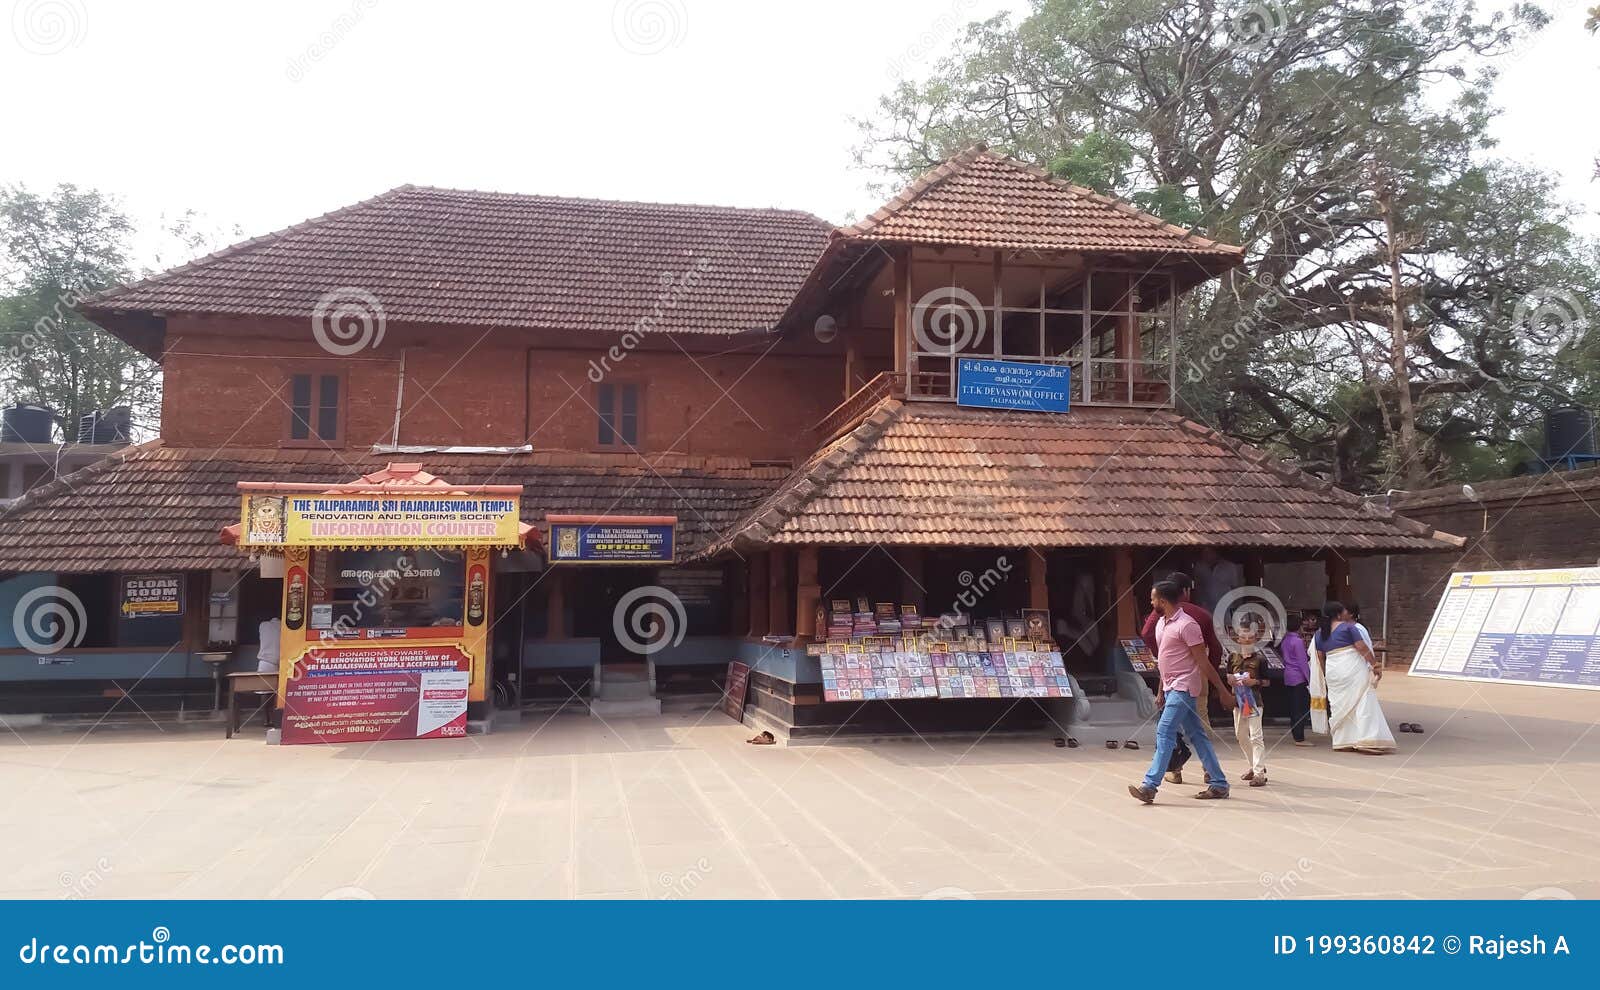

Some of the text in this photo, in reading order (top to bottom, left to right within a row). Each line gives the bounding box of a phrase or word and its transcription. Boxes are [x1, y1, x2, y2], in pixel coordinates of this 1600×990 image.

[984, 387, 1032, 398] DEVASWOM
[1034, 391, 1065, 400] OFFICE
[991, 398, 1035, 406] TALIPARAMBA
[293, 500, 514, 512] THE TALIPARAMBA SRI RAJARAJESWARA TEMPLE
[311, 522, 496, 536] INFORMATION COUNTER
[127, 580, 178, 588] CLOAK
[127, 588, 177, 596] ROOM
